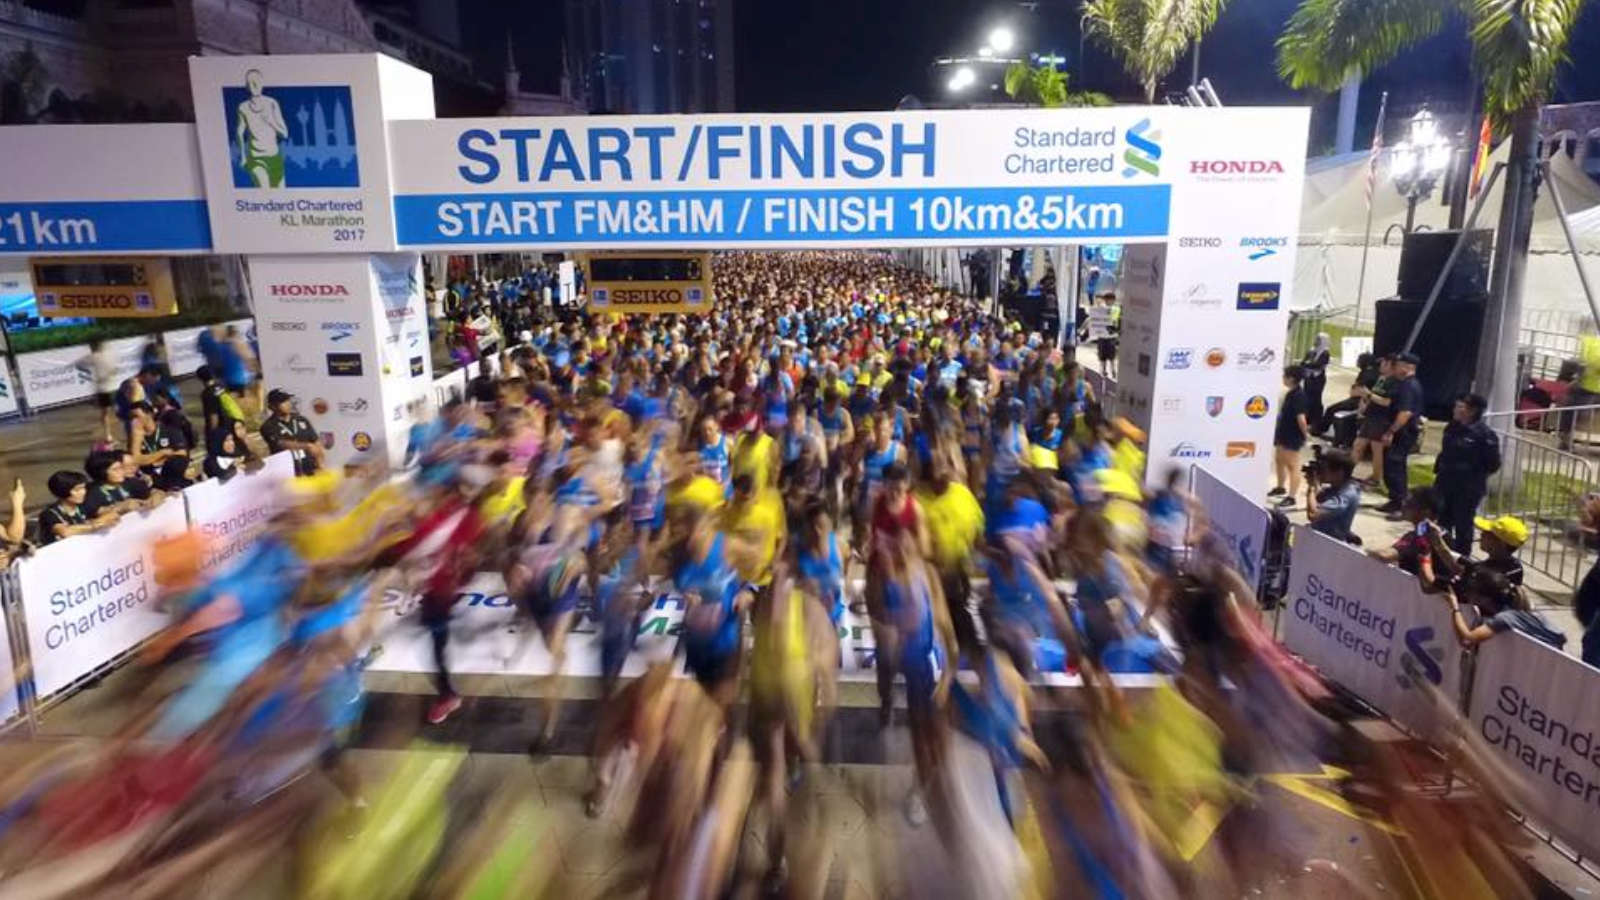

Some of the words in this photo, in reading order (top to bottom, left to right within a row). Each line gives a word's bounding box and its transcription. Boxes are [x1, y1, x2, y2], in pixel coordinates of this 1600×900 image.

[1014, 126, 1116, 148] Standard
[457, 122, 937, 185] START/FINISH
[1004, 153, 1114, 176] Chartered
[1189, 160, 1285, 174] HONDA
[235, 199, 295, 212] Standard
[297, 199, 363, 211] Chartered
[280, 214, 299, 226] KL
[301, 214, 365, 226] Marathon
[437, 200, 562, 237] START
[575, 199, 724, 236] FM&HM
[735, 197, 752, 234] /
[763, 196, 895, 234] FINISH
[909, 195, 1124, 232] 10km&5km
[333, 228, 366, 241] 2017
[1179, 236, 1222, 248] SEIKO
[1239, 236, 1288, 247] BROOKS
[270, 284, 349, 296] HONDA
[612, 288, 683, 305] SEIKO
[60, 294, 132, 310] SEIKO
[50, 555, 145, 618] Standard
[1306, 573, 1397, 640] Standard
[45, 583, 149, 651] Chartered
[1294, 597, 1390, 669] Chartered
[1481, 713, 1600, 805] Charter
